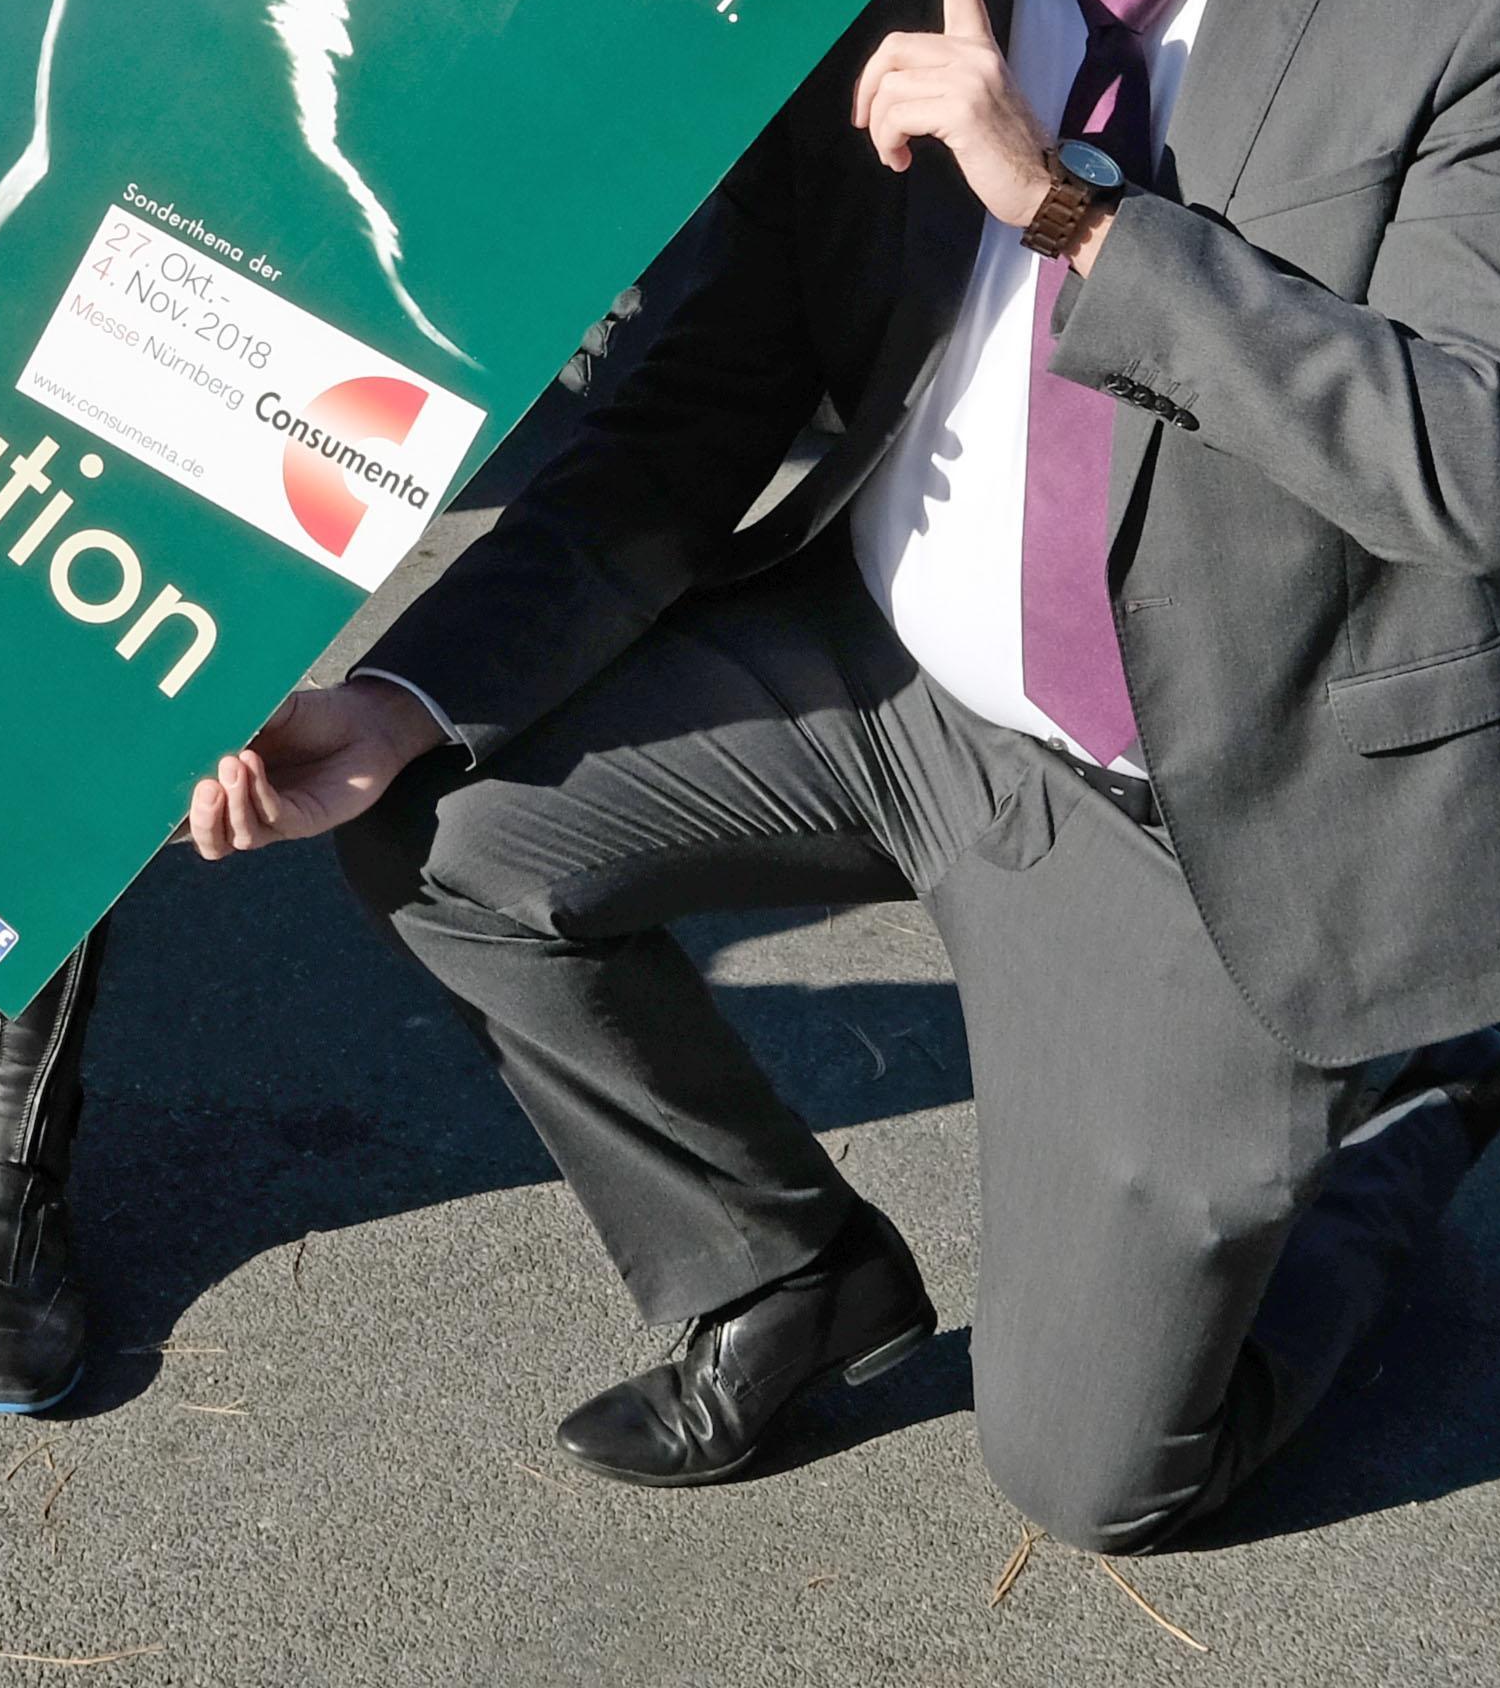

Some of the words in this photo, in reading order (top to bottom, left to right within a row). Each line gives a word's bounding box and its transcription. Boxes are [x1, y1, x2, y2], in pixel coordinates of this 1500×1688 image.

[105, 223, 152, 268] 27.
[161, 253, 230, 303] Okt.-
[122, 182, 244, 261] Sonderthema
[249, 254, 282, 281] der
[70, 294, 139, 346] Messe
[142, 335, 245, 410] Nürnberg
[92, 256, 114, 286] 4.
[125, 270, 189, 327] Nov.
[195, 312, 272, 369] 2018
[33, 372, 204, 478] www.consumenta.de
[255, 391, 430, 510] Consumenta
